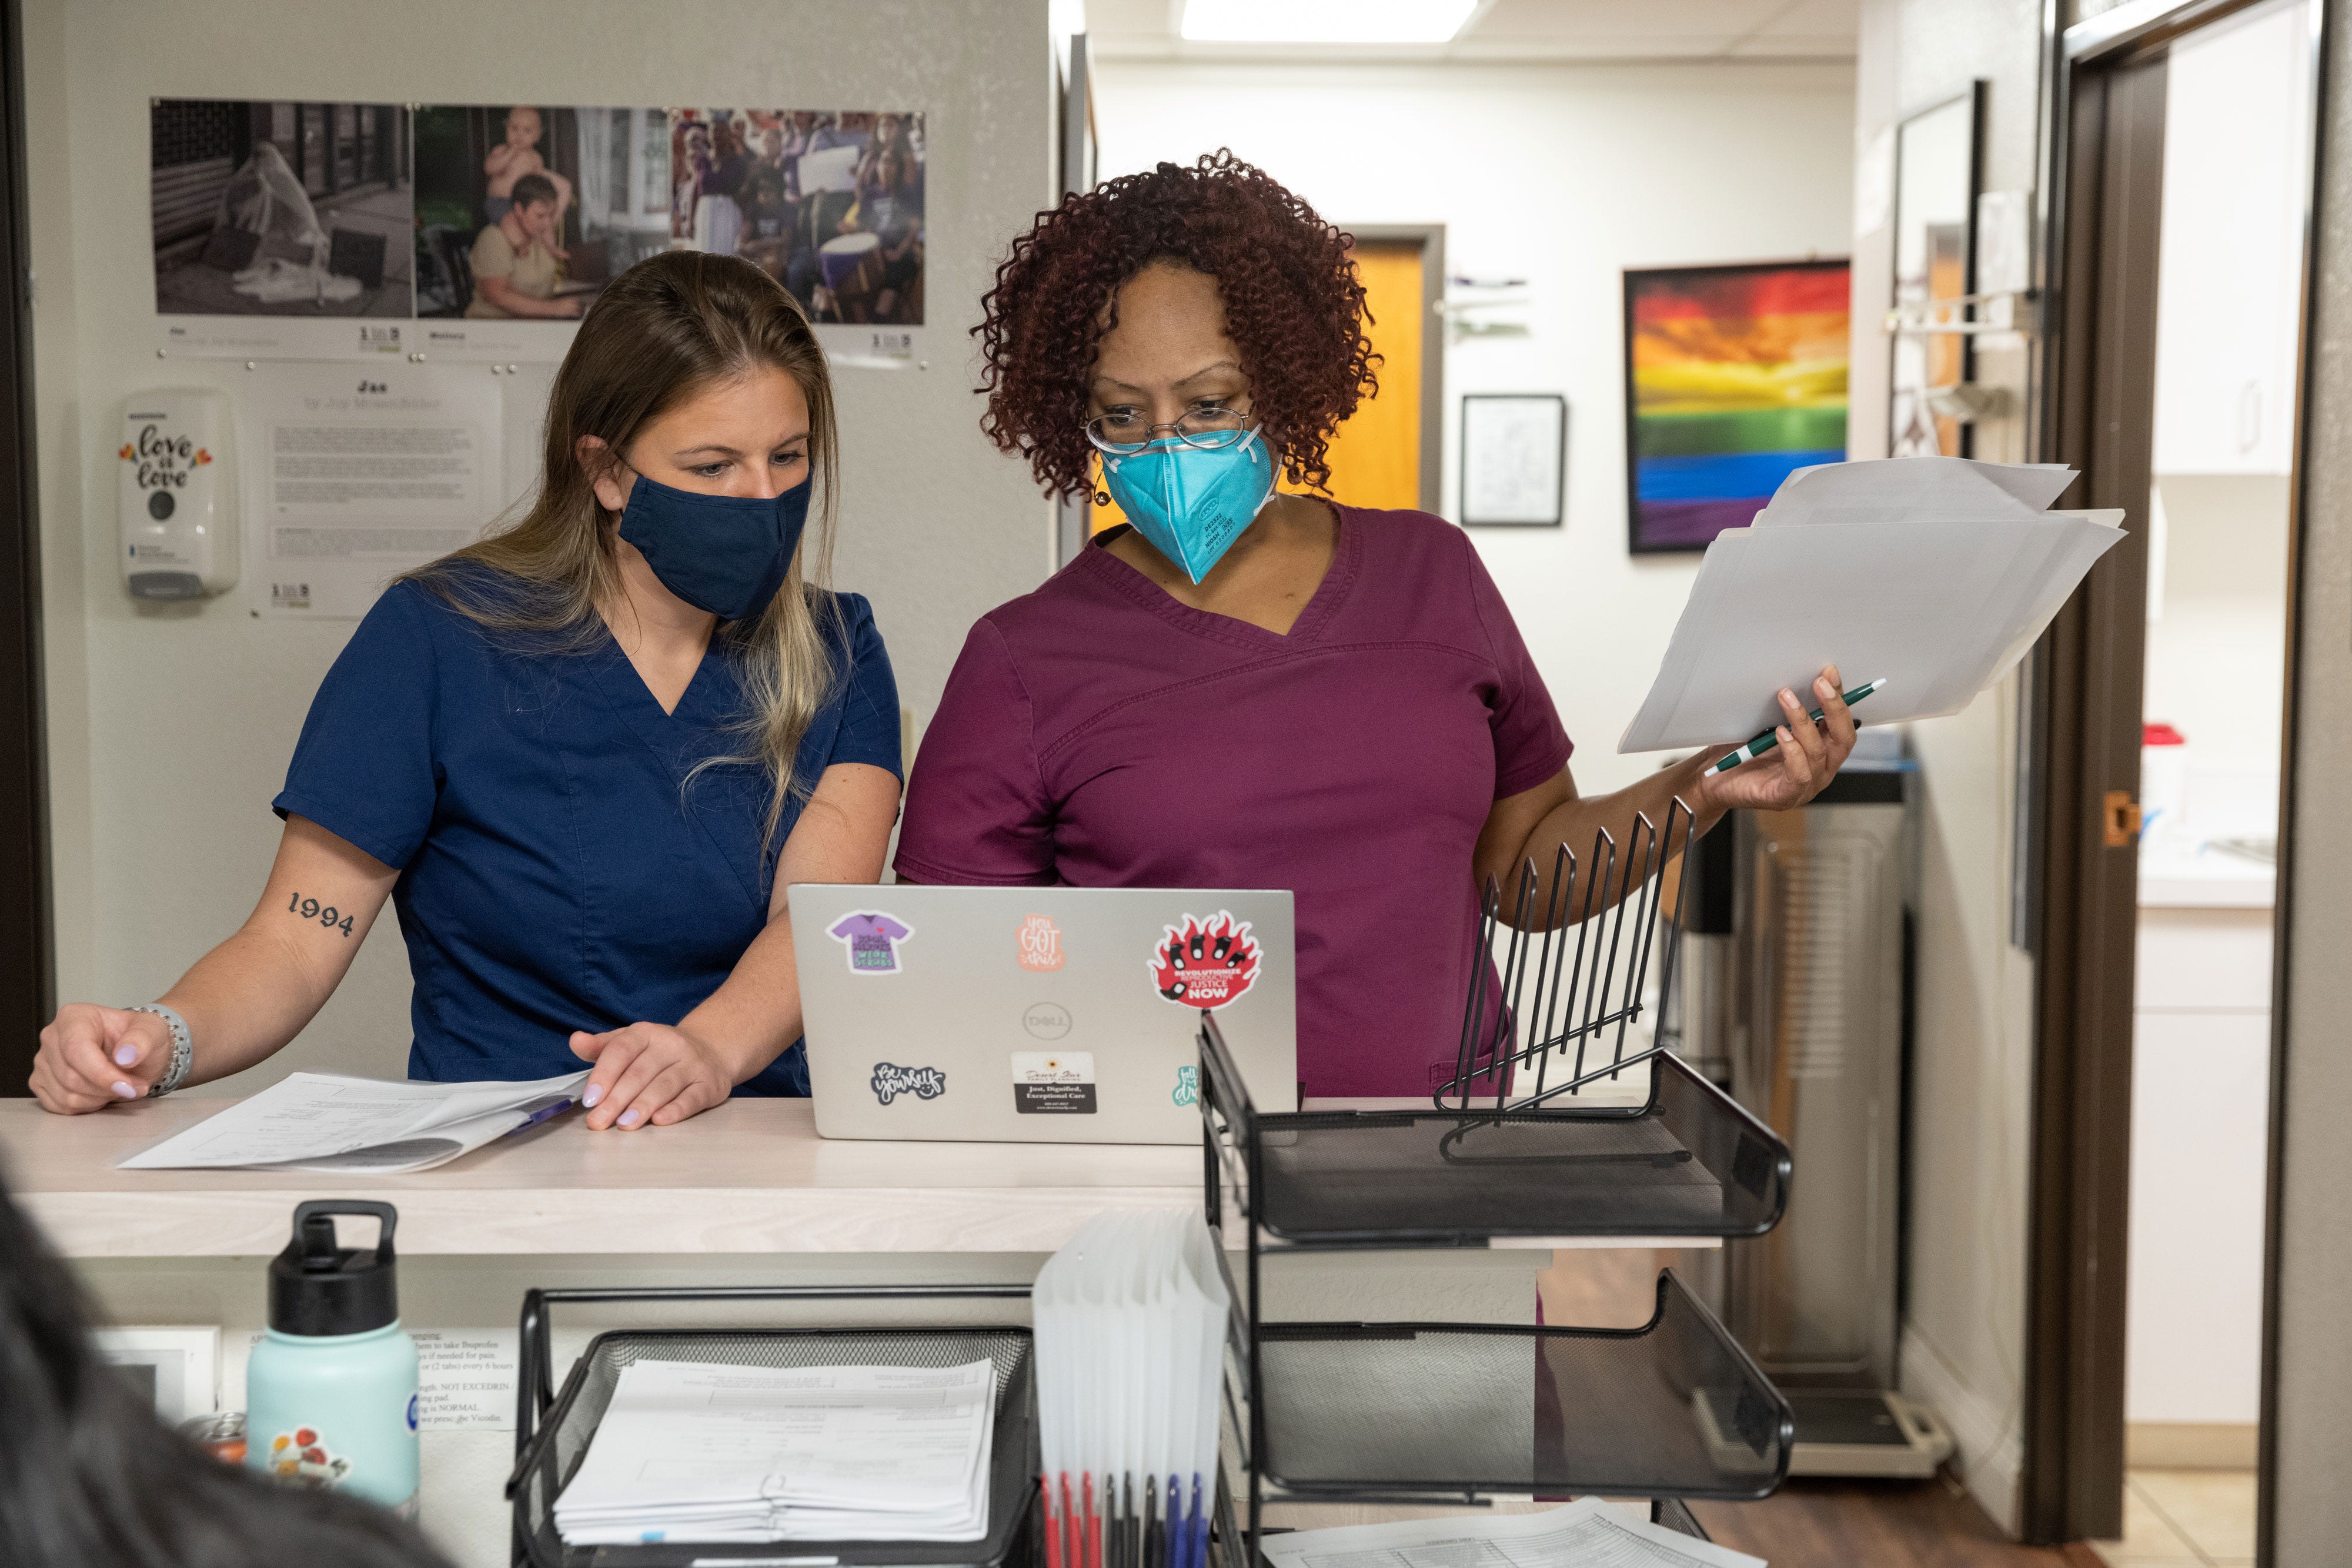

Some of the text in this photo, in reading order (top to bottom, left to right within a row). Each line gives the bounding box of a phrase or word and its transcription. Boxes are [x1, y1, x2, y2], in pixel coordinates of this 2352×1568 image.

[139, 424, 192, 458] love
[138, 462, 188, 489] love
[1205, 531, 1220, 548] NIOSH
[289, 892, 354, 937] 1994
[1021, 929, 1061, 954] GOT
[1191, 980, 1228, 988] JUSTICE
[1188, 988, 1228, 999] NOW
[877, 1065, 901, 1079] Be
[875, 1069, 943, 1102] yourself
[462, 1341, 499, 1351] Ibuprofen
[442, 1362, 460, 1371] tabs)
